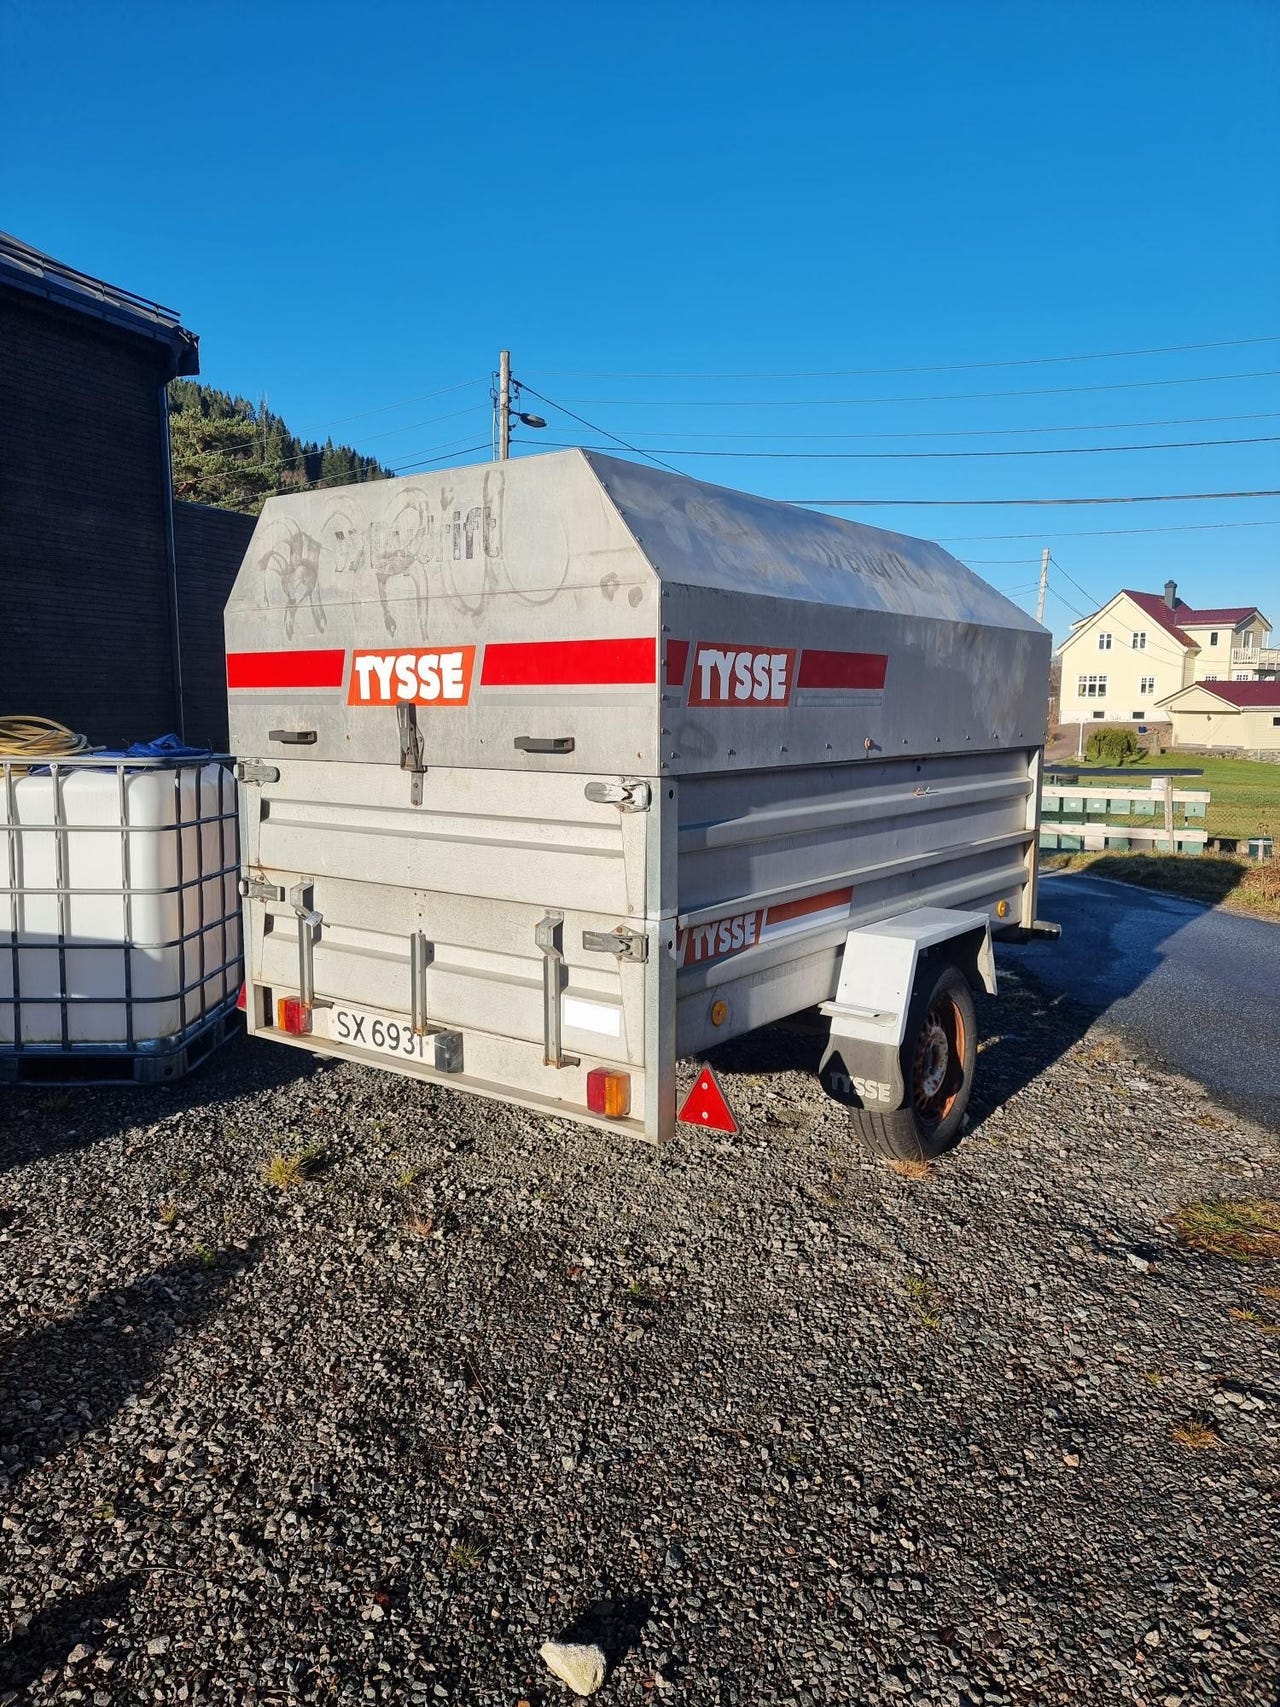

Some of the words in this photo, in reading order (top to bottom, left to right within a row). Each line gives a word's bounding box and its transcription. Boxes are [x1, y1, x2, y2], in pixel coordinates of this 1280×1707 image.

[355, 651, 464, 700] TYSSE
[698, 649, 787, 700] TYSSE
[693, 911, 757, 961] TYSSE
[337, 1010, 367, 1043] SX
[829, 1071, 892, 1103] TYSSE
